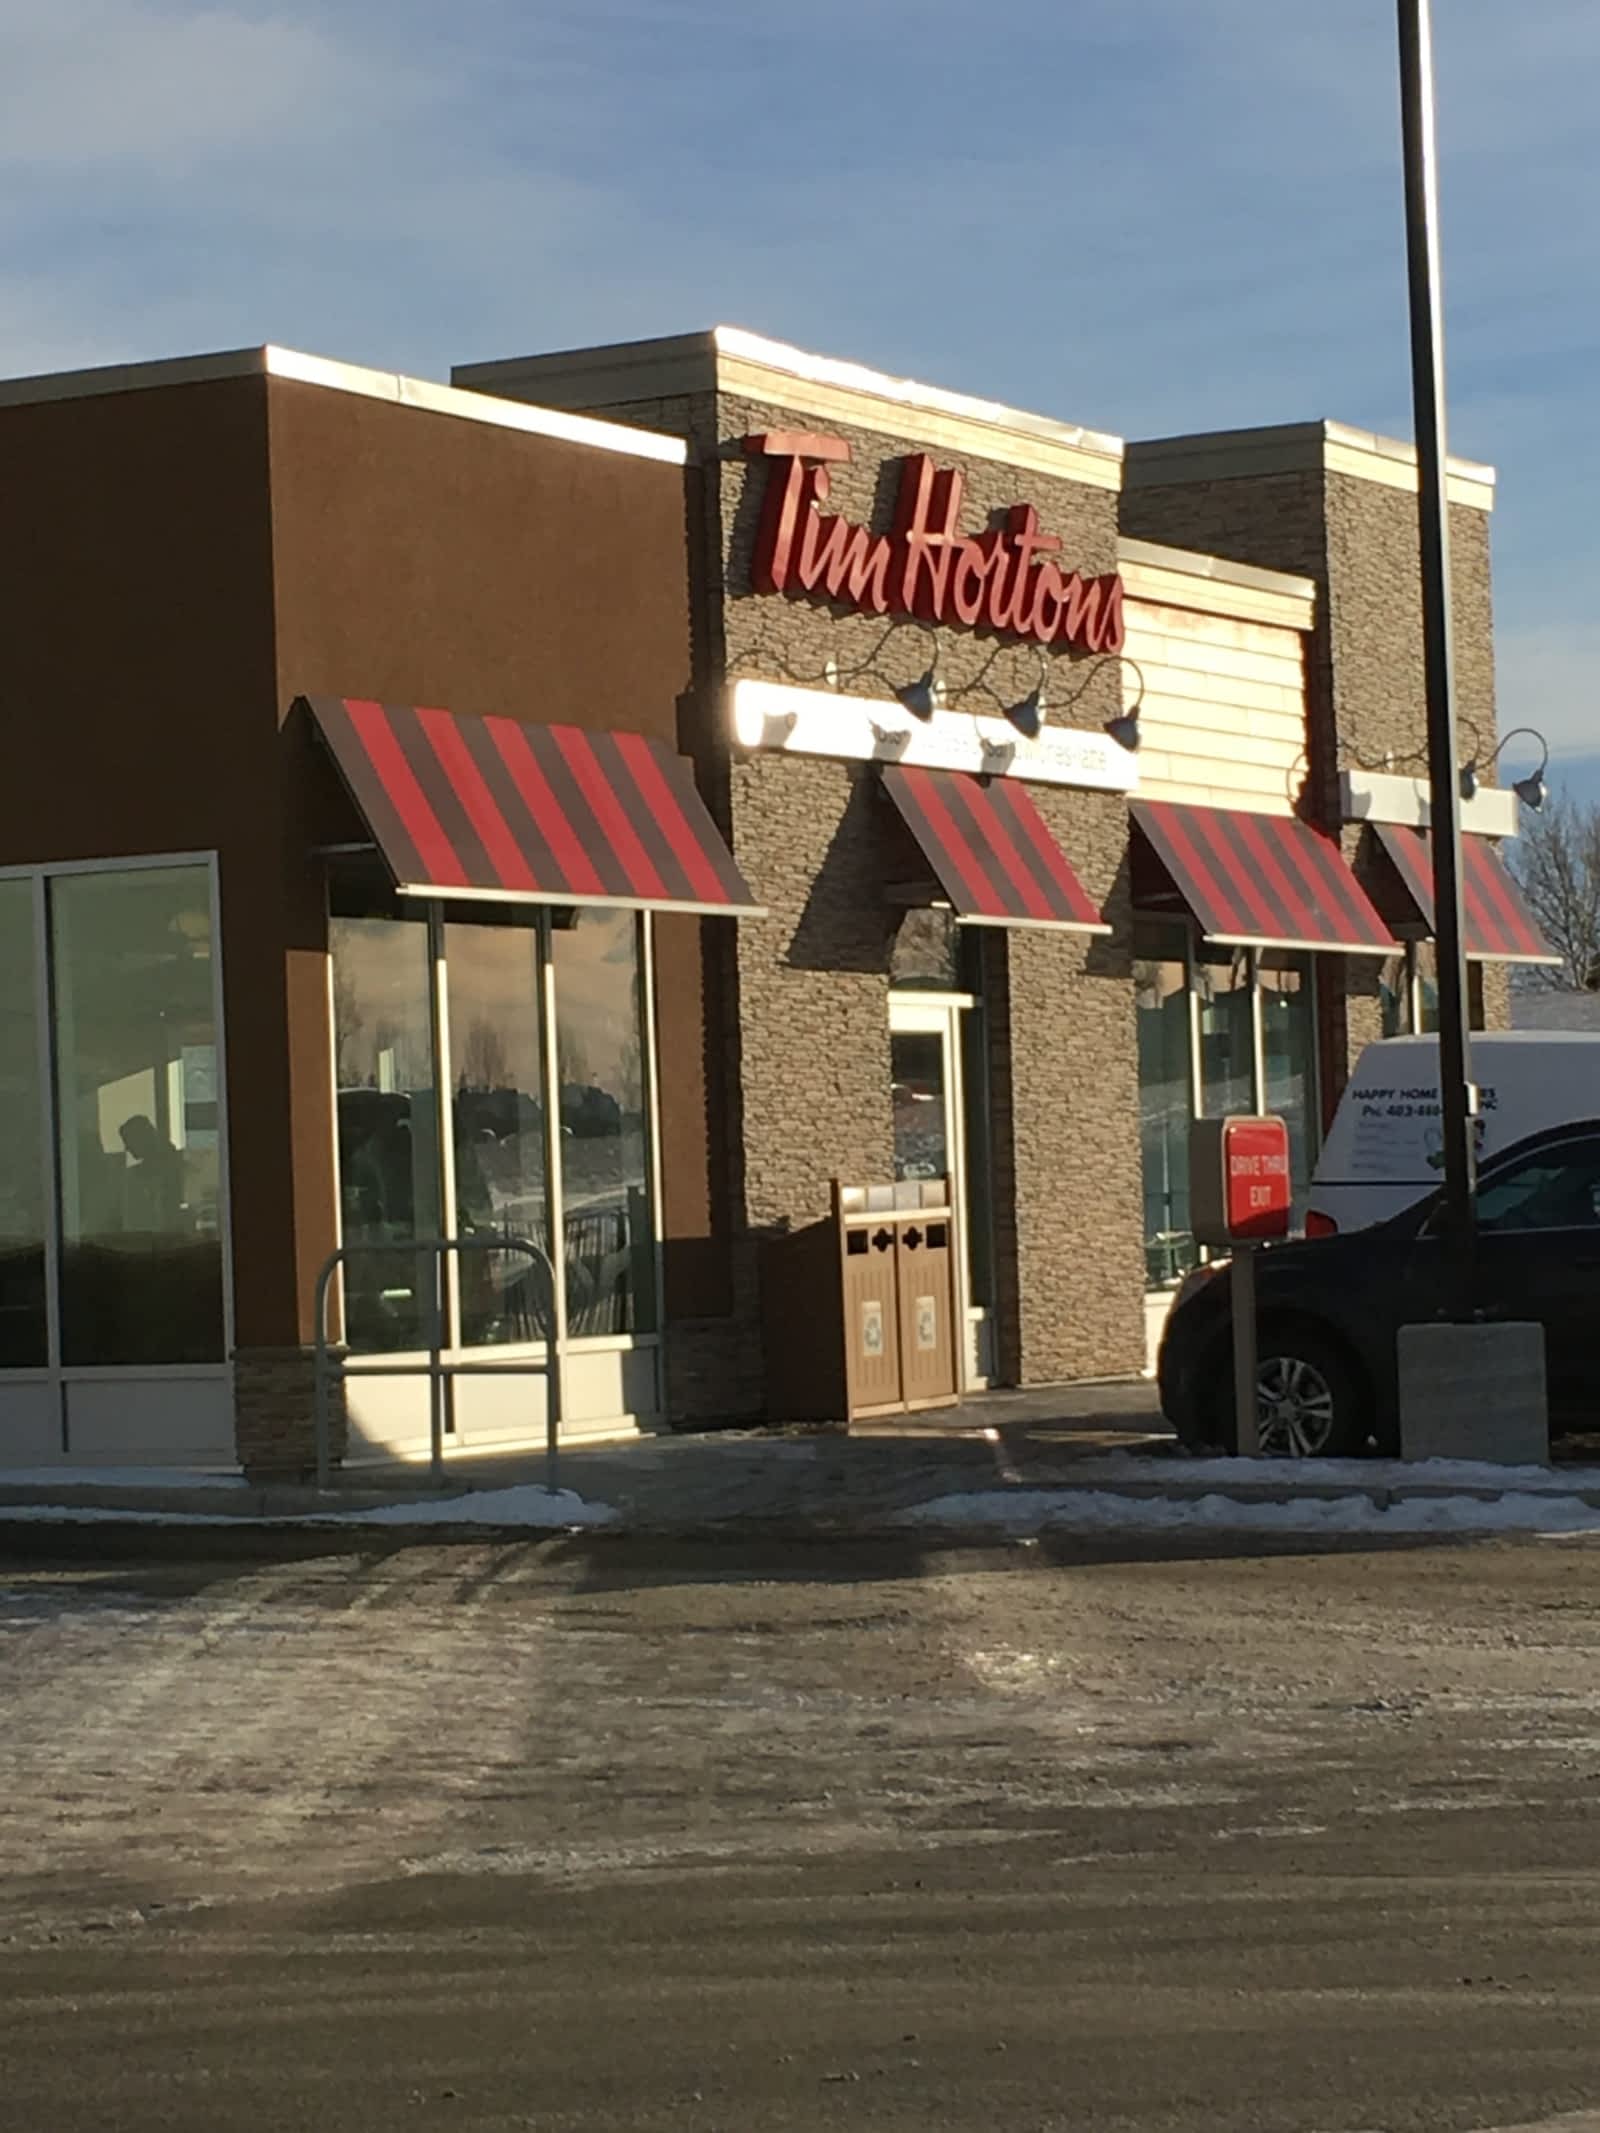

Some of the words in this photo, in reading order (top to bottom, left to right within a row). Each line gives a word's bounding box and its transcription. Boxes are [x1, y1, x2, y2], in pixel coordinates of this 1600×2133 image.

[746, 431, 892, 614] Tim
[900, 452, 1125, 655] Hortons
[1352, 1088, 1396, 1099] HAPPY
[1400, 1087, 1438, 1099] HOME
[1231, 1154, 1260, 1176] DRIVE
[1261, 1154, 1289, 1176] THRU
[1250, 1185, 1272, 1207] EXIT
